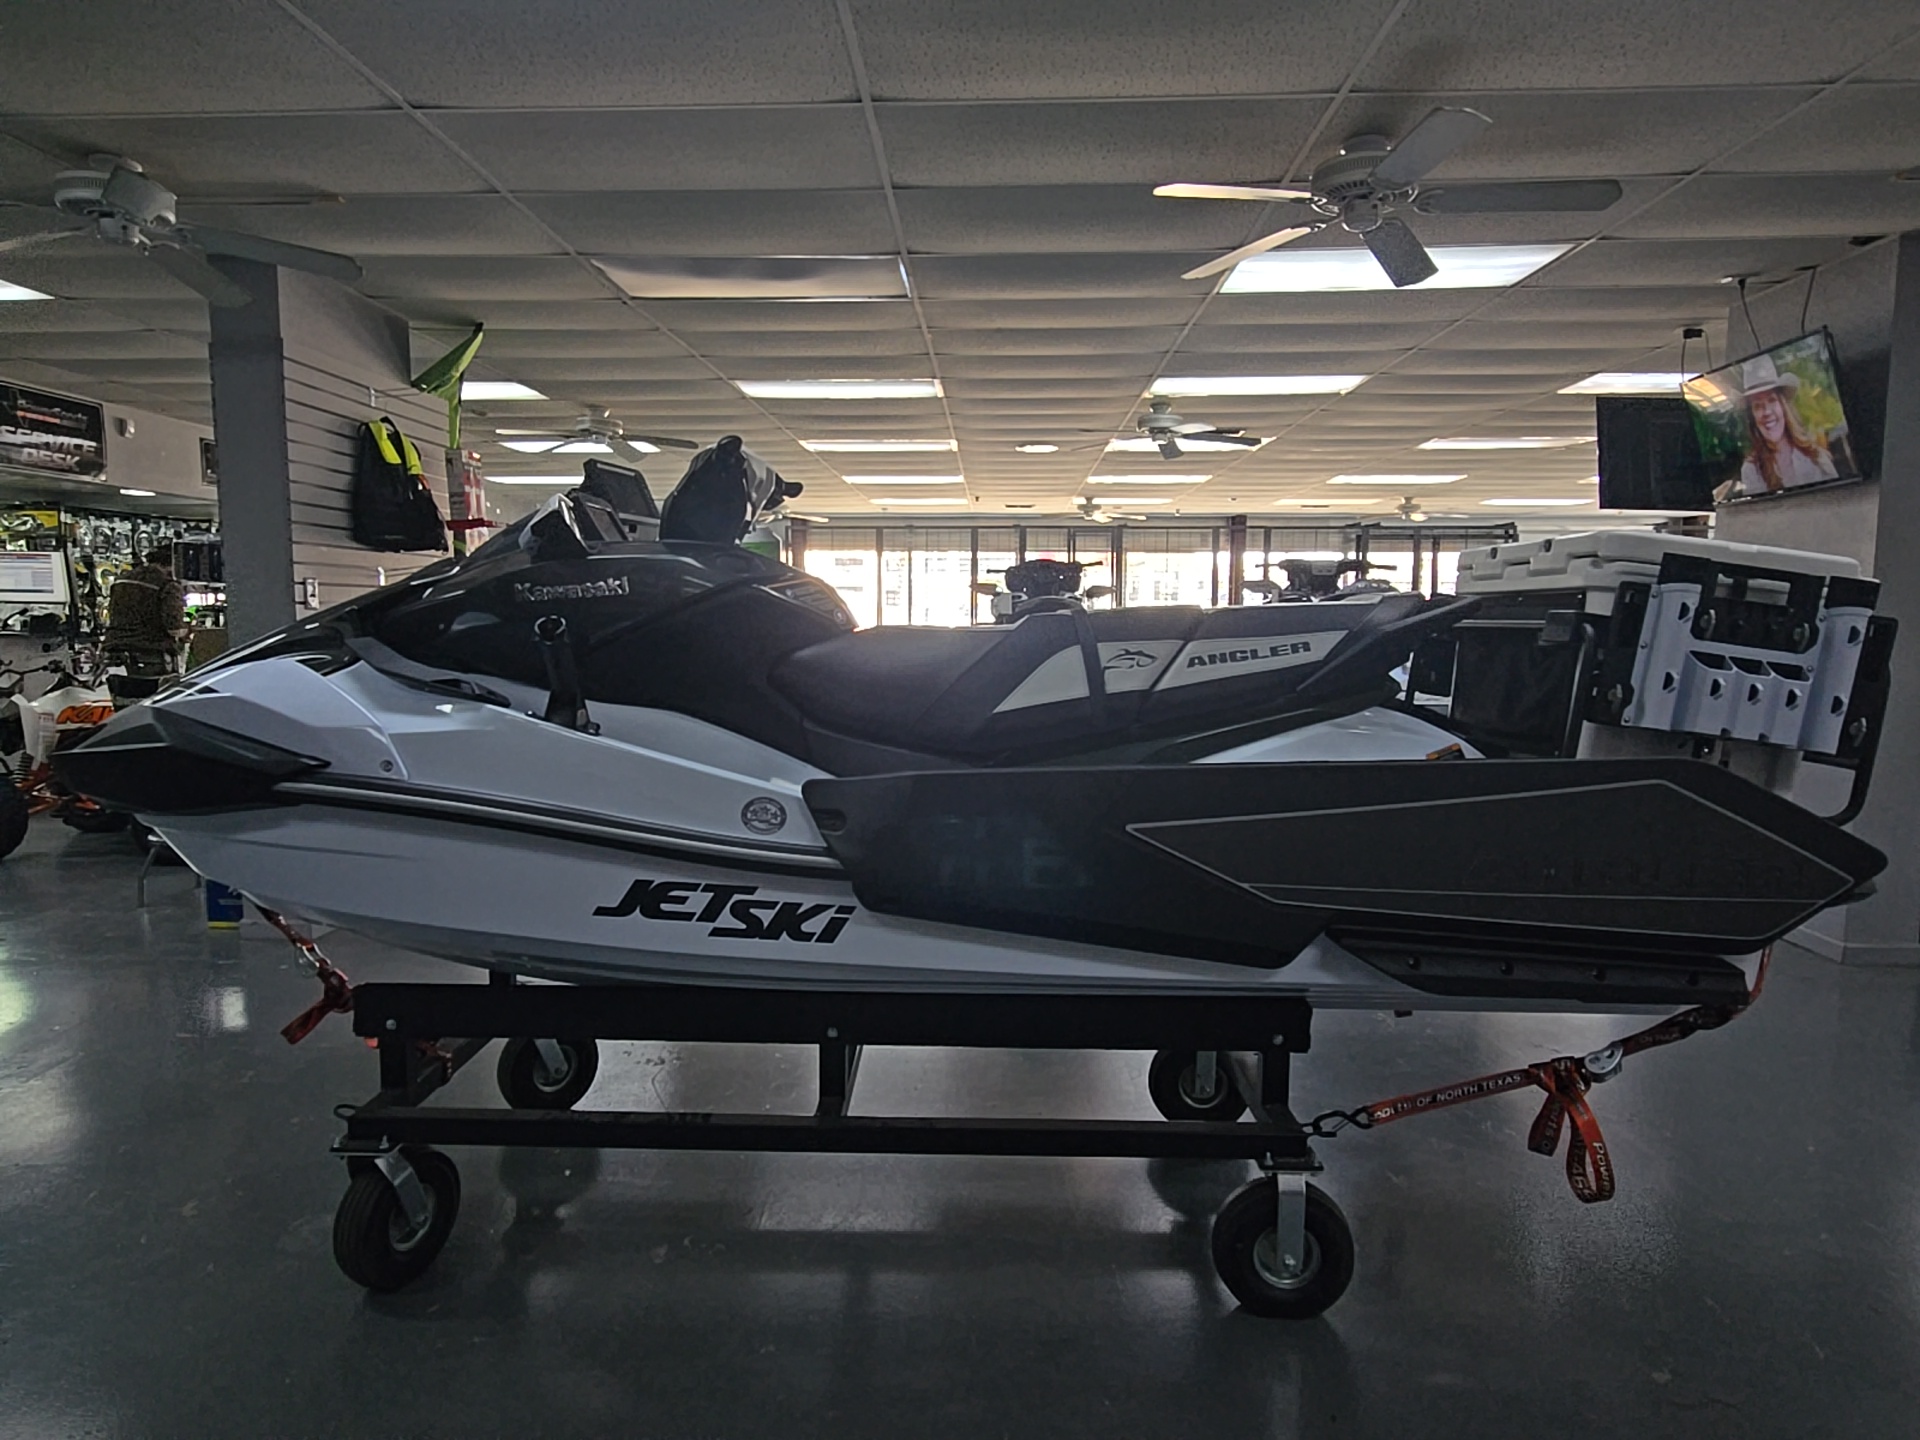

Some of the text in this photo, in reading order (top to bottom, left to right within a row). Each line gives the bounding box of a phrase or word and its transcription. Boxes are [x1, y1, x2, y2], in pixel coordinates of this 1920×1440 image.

[0, 425, 97, 453] SERVICE
[21, 447, 81, 472] DESK
[513, 575, 630, 602] Kawasaki
[1187, 641, 1311, 668] ANGLER
[1434, 1083, 1479, 1103] NORTH
[1482, 1073, 1522, 1092] TEXAS
